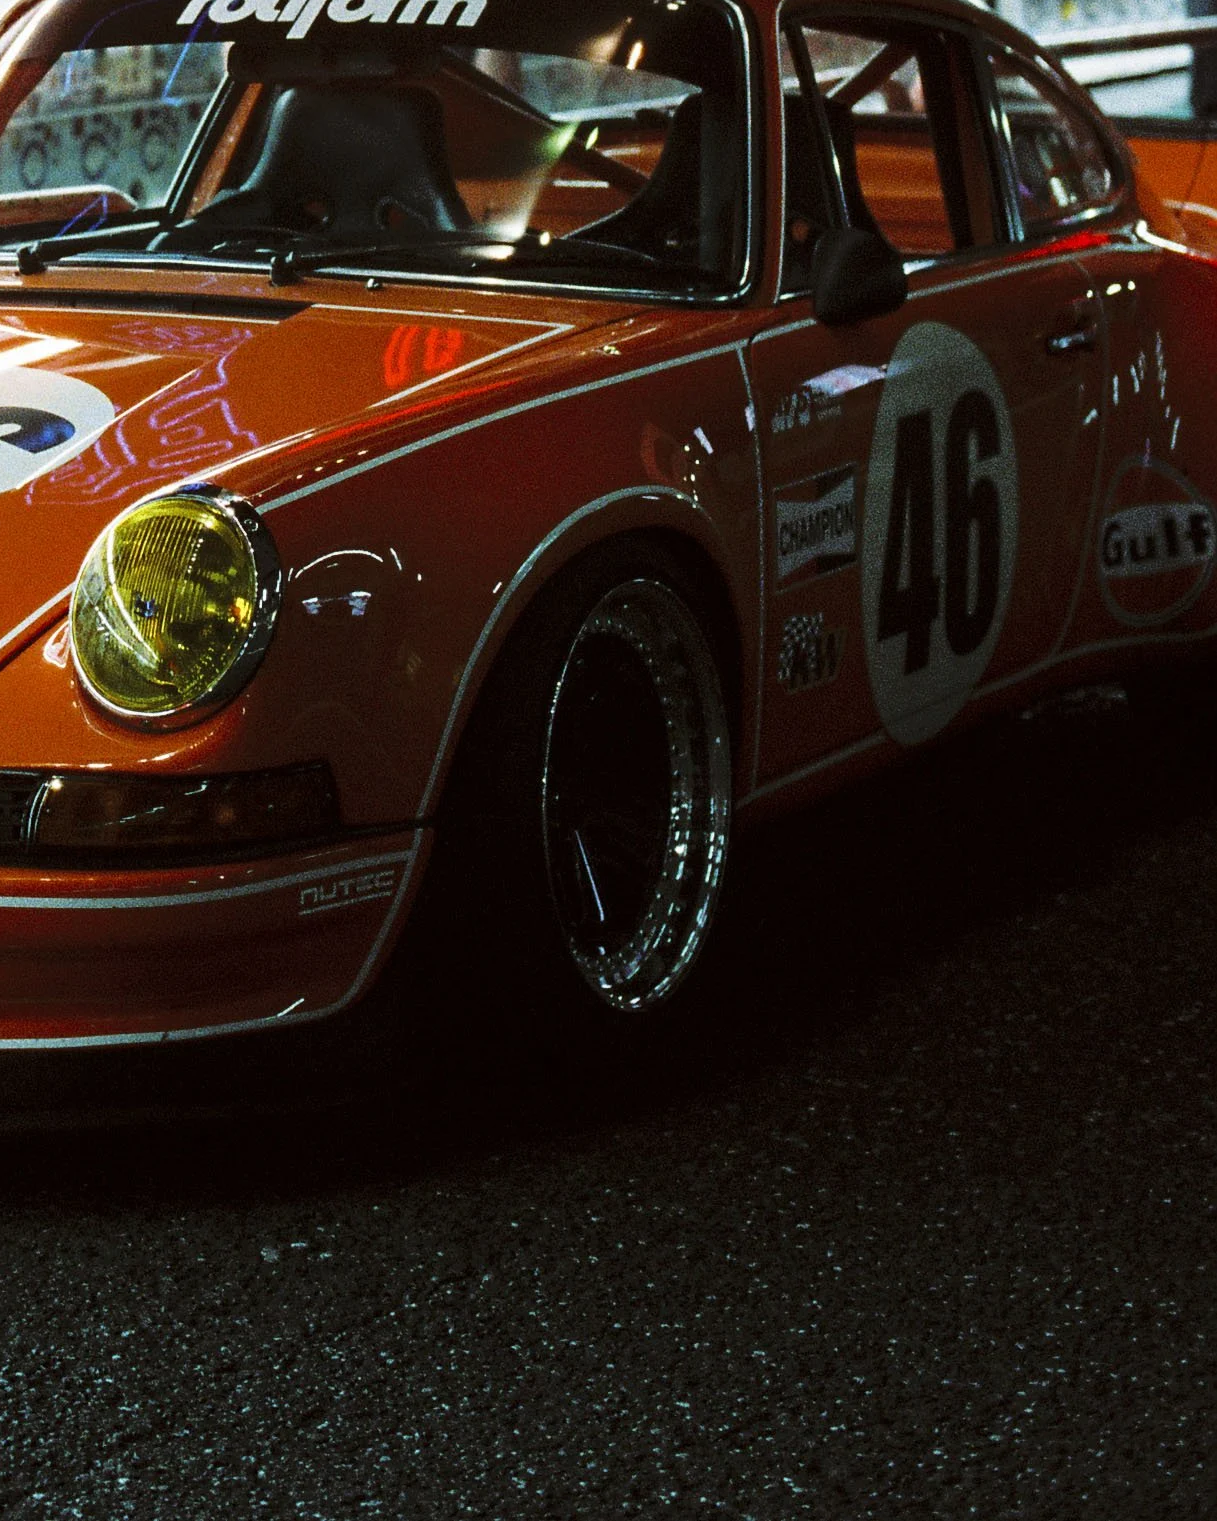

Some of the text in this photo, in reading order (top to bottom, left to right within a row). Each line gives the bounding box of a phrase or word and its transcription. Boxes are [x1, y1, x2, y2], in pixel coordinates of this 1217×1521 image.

[780, 501, 856, 557] CHAMPION
[876, 389, 1002, 677] 46
[1102, 511, 1215, 569] Gulf
